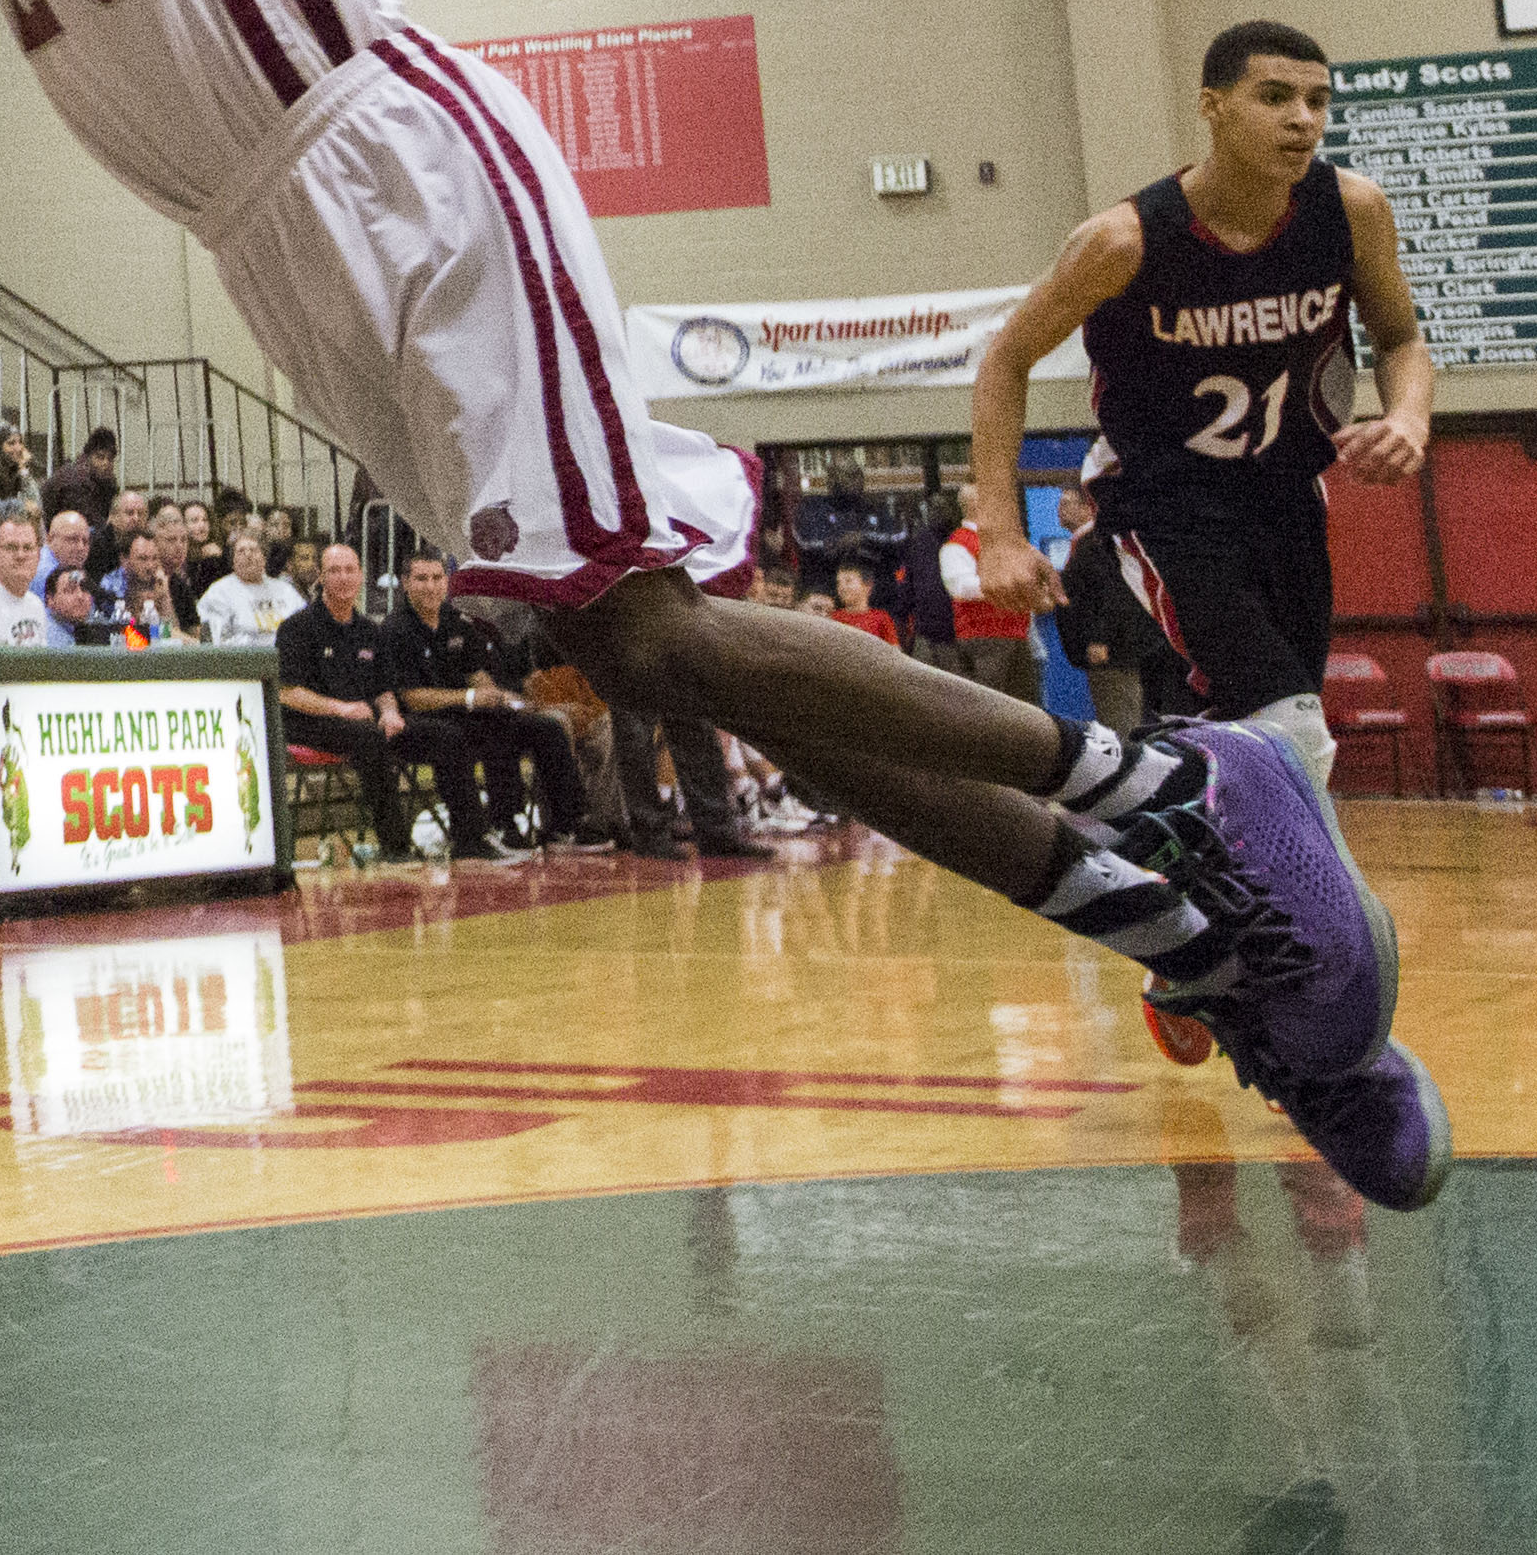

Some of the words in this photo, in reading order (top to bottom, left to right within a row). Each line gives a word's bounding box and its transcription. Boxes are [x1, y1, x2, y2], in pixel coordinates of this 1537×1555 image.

[597, 27, 635, 47] State
[1334, 68, 1409, 94] Lady
[1419, 59, 1513, 87] Scots
[1423, 99, 1507, 119] Sanders
[1184, 370, 1289, 459] 21
[37, 711, 161, 757] HIGHLAND
[165, 708, 226, 752] PARK
[60, 762, 215, 845] SCOTS
